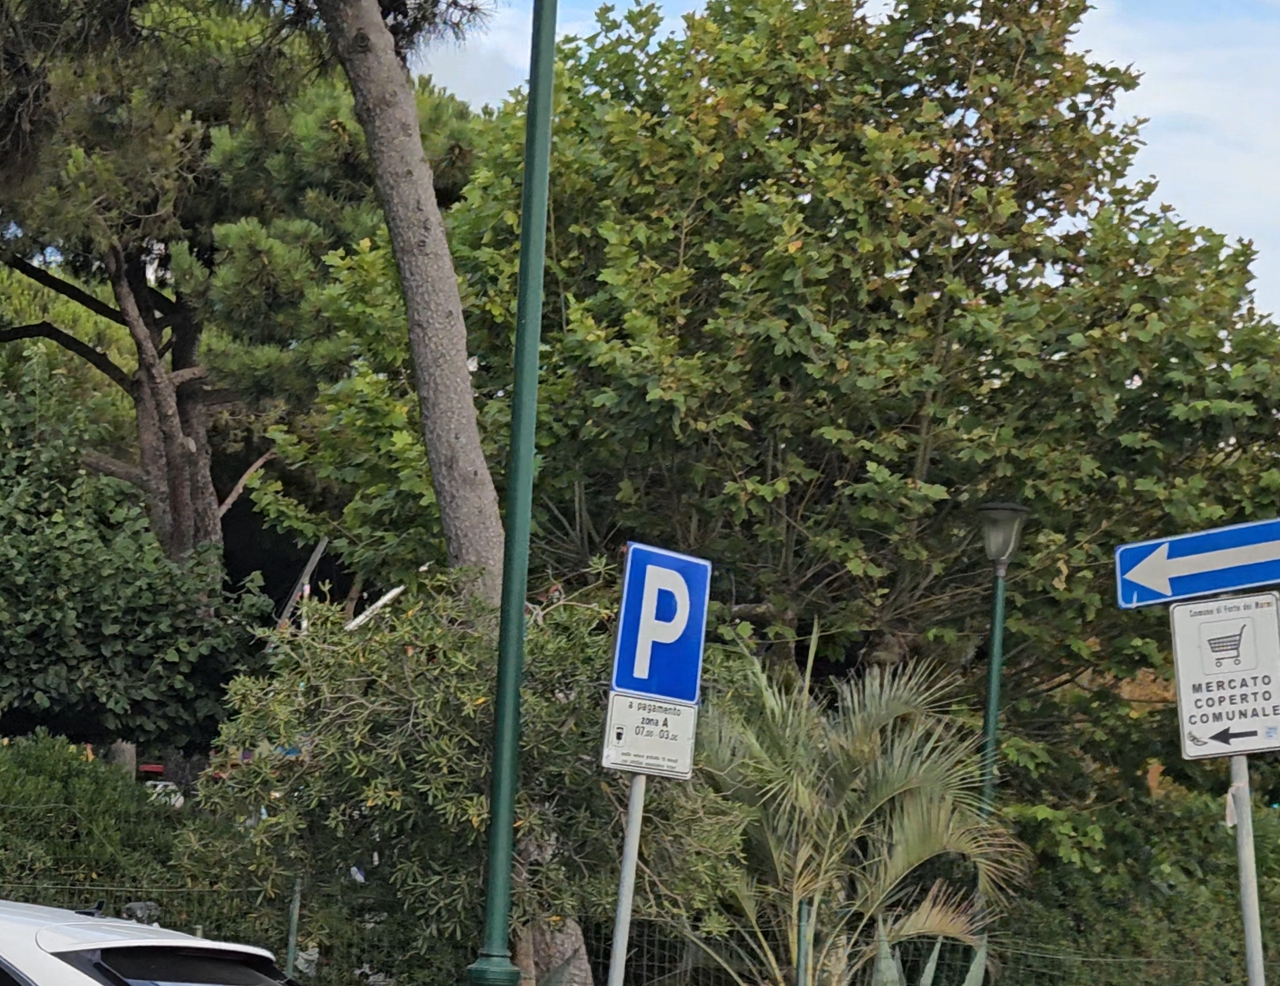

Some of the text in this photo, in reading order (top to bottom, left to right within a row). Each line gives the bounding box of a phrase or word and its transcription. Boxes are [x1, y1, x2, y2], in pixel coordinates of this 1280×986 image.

[633, 564, 690, 680] P
[1191, 674, 1272, 695] MERCATO
[1194, 690, 1272, 709] COPERTO
[637, 702, 682, 717] pagamento
[1188, 705, 1280, 725] COMUNALE
[640, 717, 669, 728] zona A
